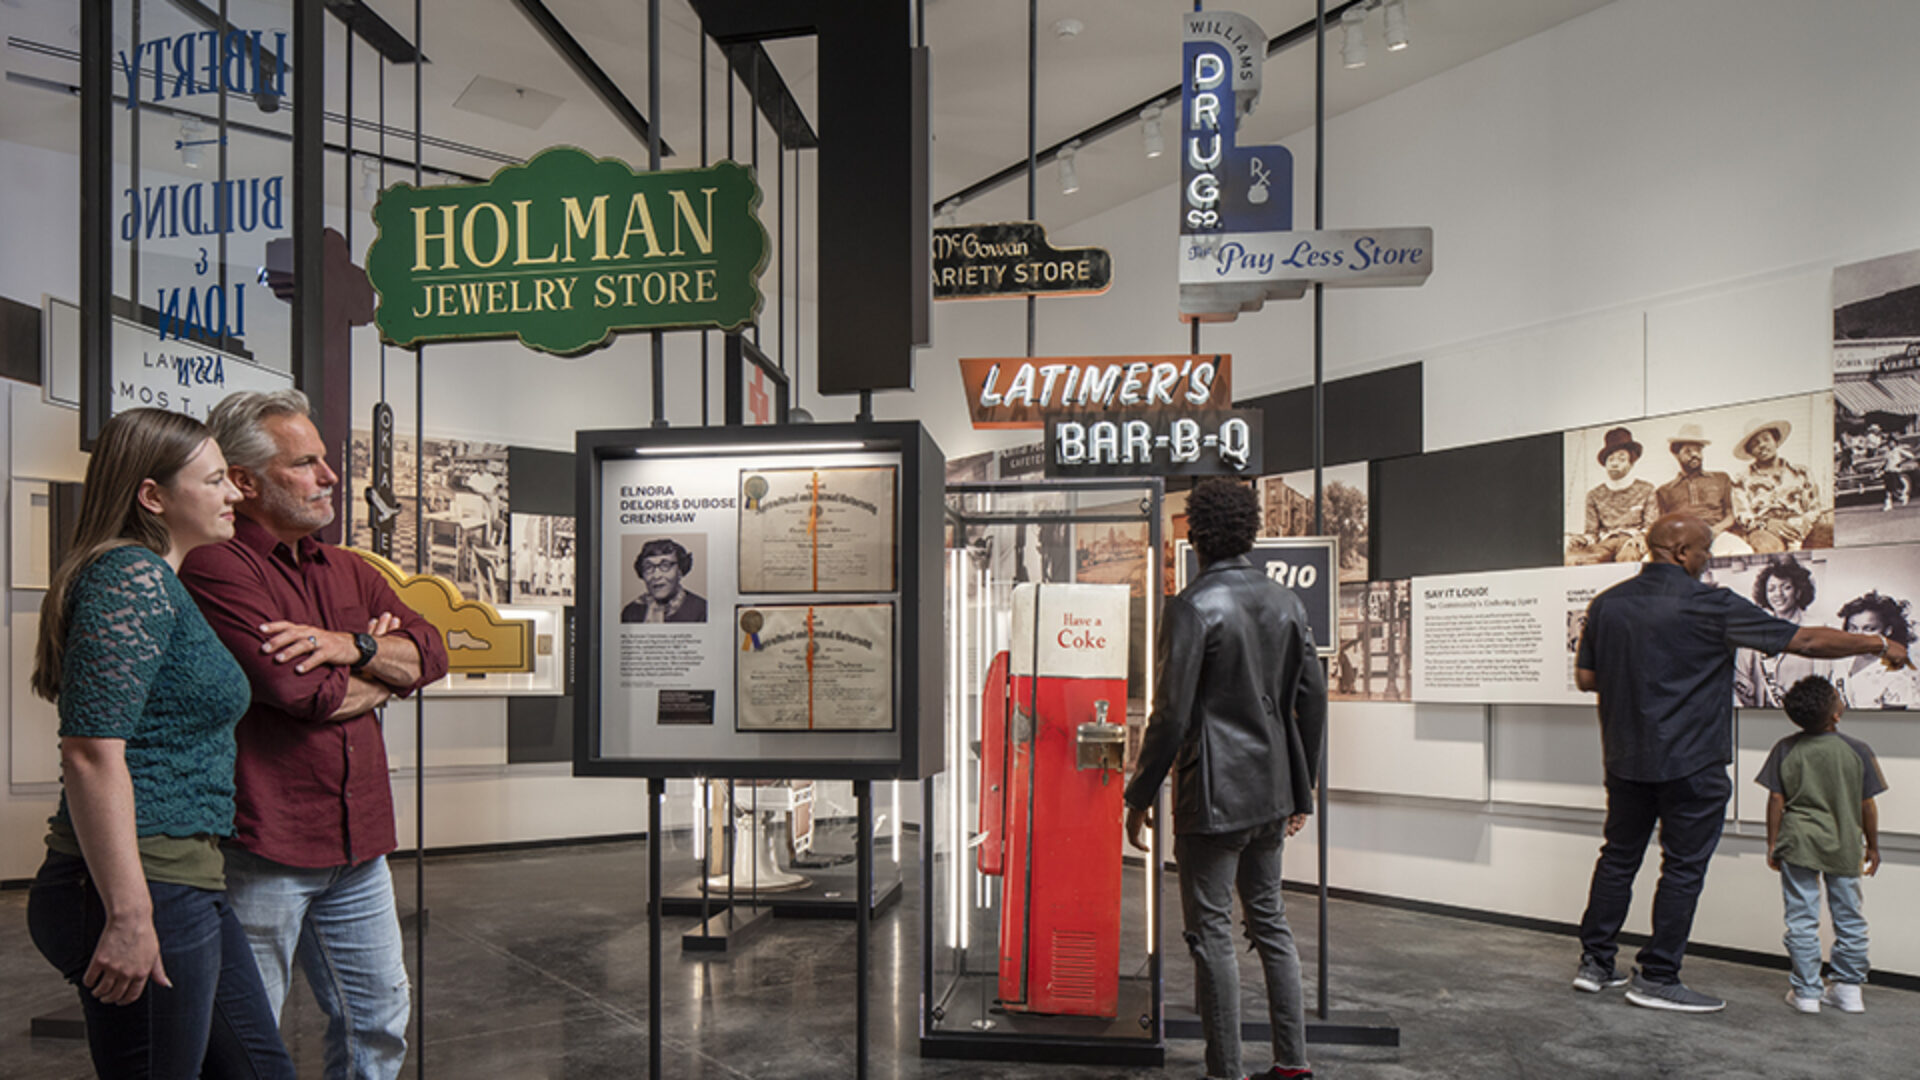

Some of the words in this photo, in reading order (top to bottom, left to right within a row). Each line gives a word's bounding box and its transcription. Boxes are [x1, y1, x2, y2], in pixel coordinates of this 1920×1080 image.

[1190, 21, 1253, 81] WILLIAMS
[410, 187, 718, 272] HOLMAN
[1216, 241, 1275, 276] Pay
[1281, 240, 1345, 268] Less
[1349, 236, 1424, 271] Store
[931, 264, 1007, 287] ARIETY
[1014, 260, 1091, 283] STORE
[412, 277, 579, 318] JEWELRY
[594, 269, 718, 307] STORE
[980, 360, 1215, 407] LATIMER'S
[1056, 418, 1250, 471] BAR-B-Q
[620, 486, 674, 497] ELNORA
[620, 499, 680, 511] DELORES
[682, 498, 736, 509] DUBOSE
[620, 512, 696, 524] CRENSHAW
[1063, 612, 1092, 626] Have
[1094, 618, 1102, 626] a
[1057, 628, 1106, 649] Coke
